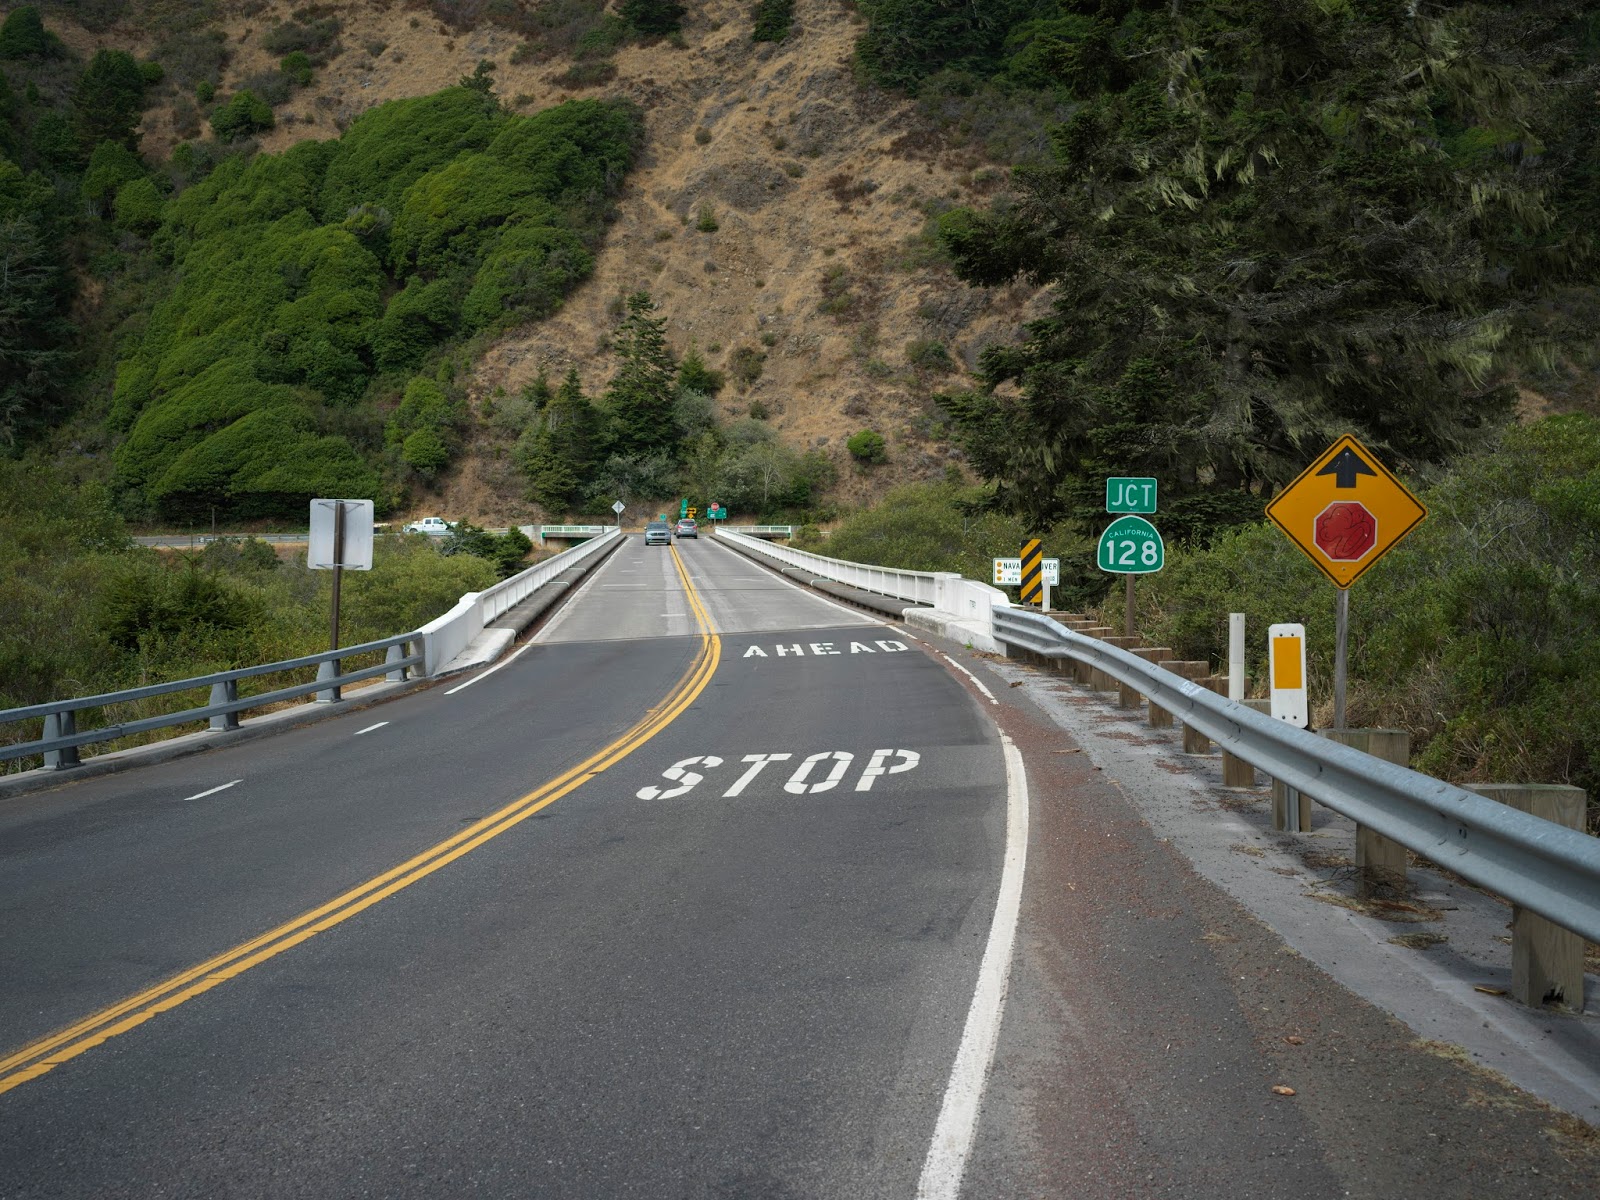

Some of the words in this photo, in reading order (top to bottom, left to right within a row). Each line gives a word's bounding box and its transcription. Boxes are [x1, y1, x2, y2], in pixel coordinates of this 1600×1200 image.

[1111, 484, 1152, 506] JCT
[1108, 529, 1154, 539] CALIFORNIA
[1106, 540, 1158, 566] 128
[1003, 562, 1021, 570] NAVA
[1041, 562, 1057, 570] IVER
[743, 640, 909, 658] AHEAD
[636, 749, 921, 800] STOP
